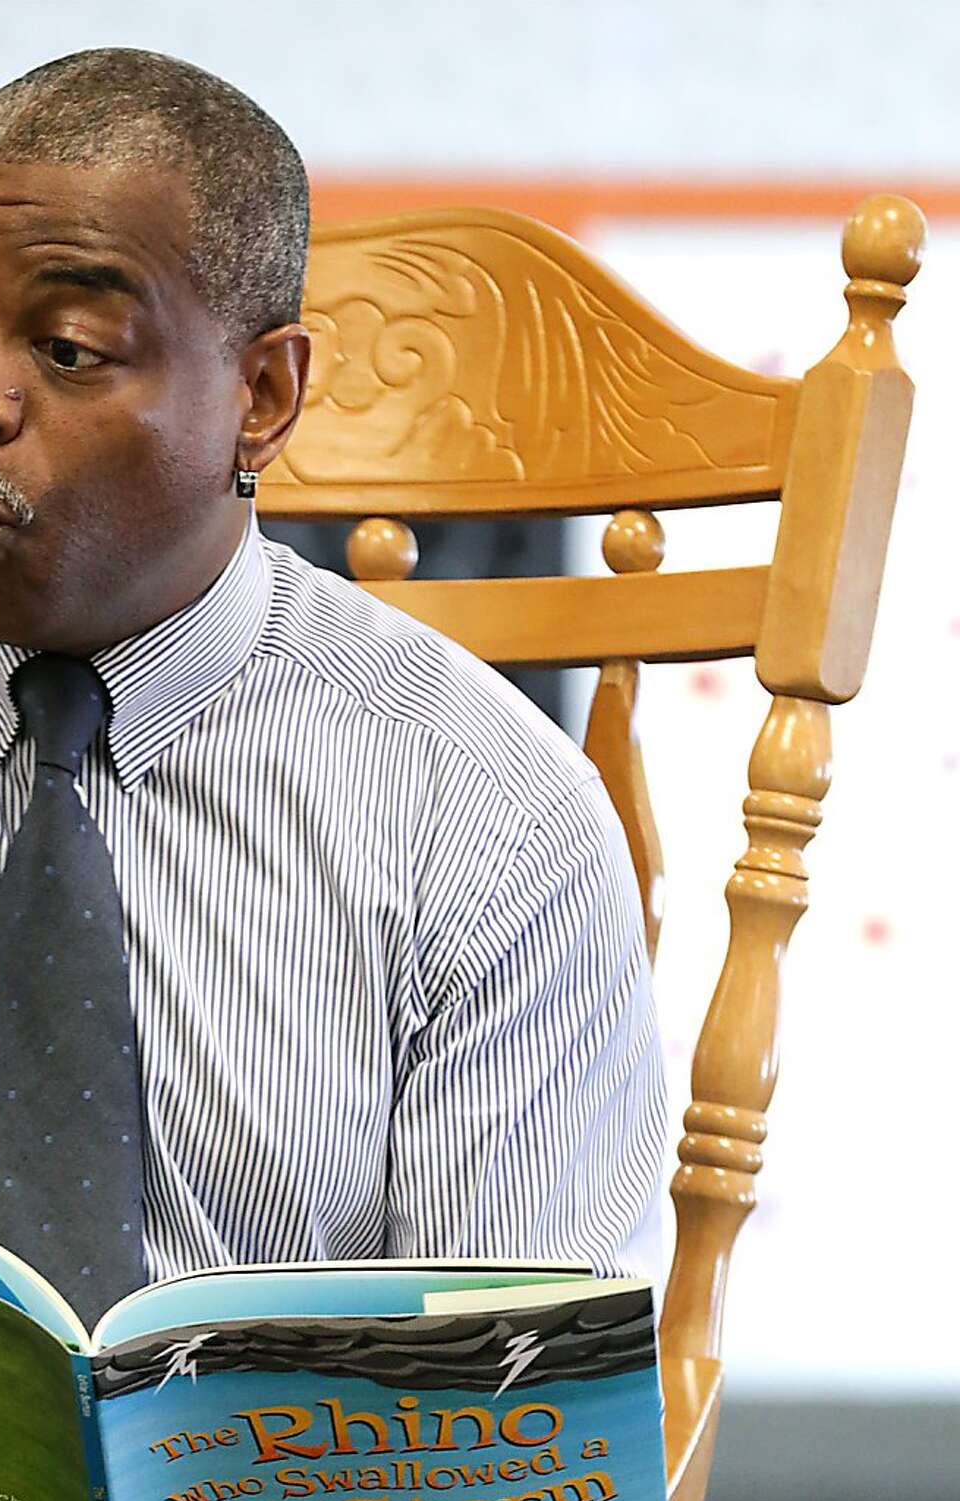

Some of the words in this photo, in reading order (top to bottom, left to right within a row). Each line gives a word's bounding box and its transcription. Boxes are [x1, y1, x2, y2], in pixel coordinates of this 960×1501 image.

[149, 1427, 241, 1462] The
[230, 1396, 565, 1464] Rhino
[275, 1445, 567, 1499] Swallowed
[581, 1437, 609, 1459] a
